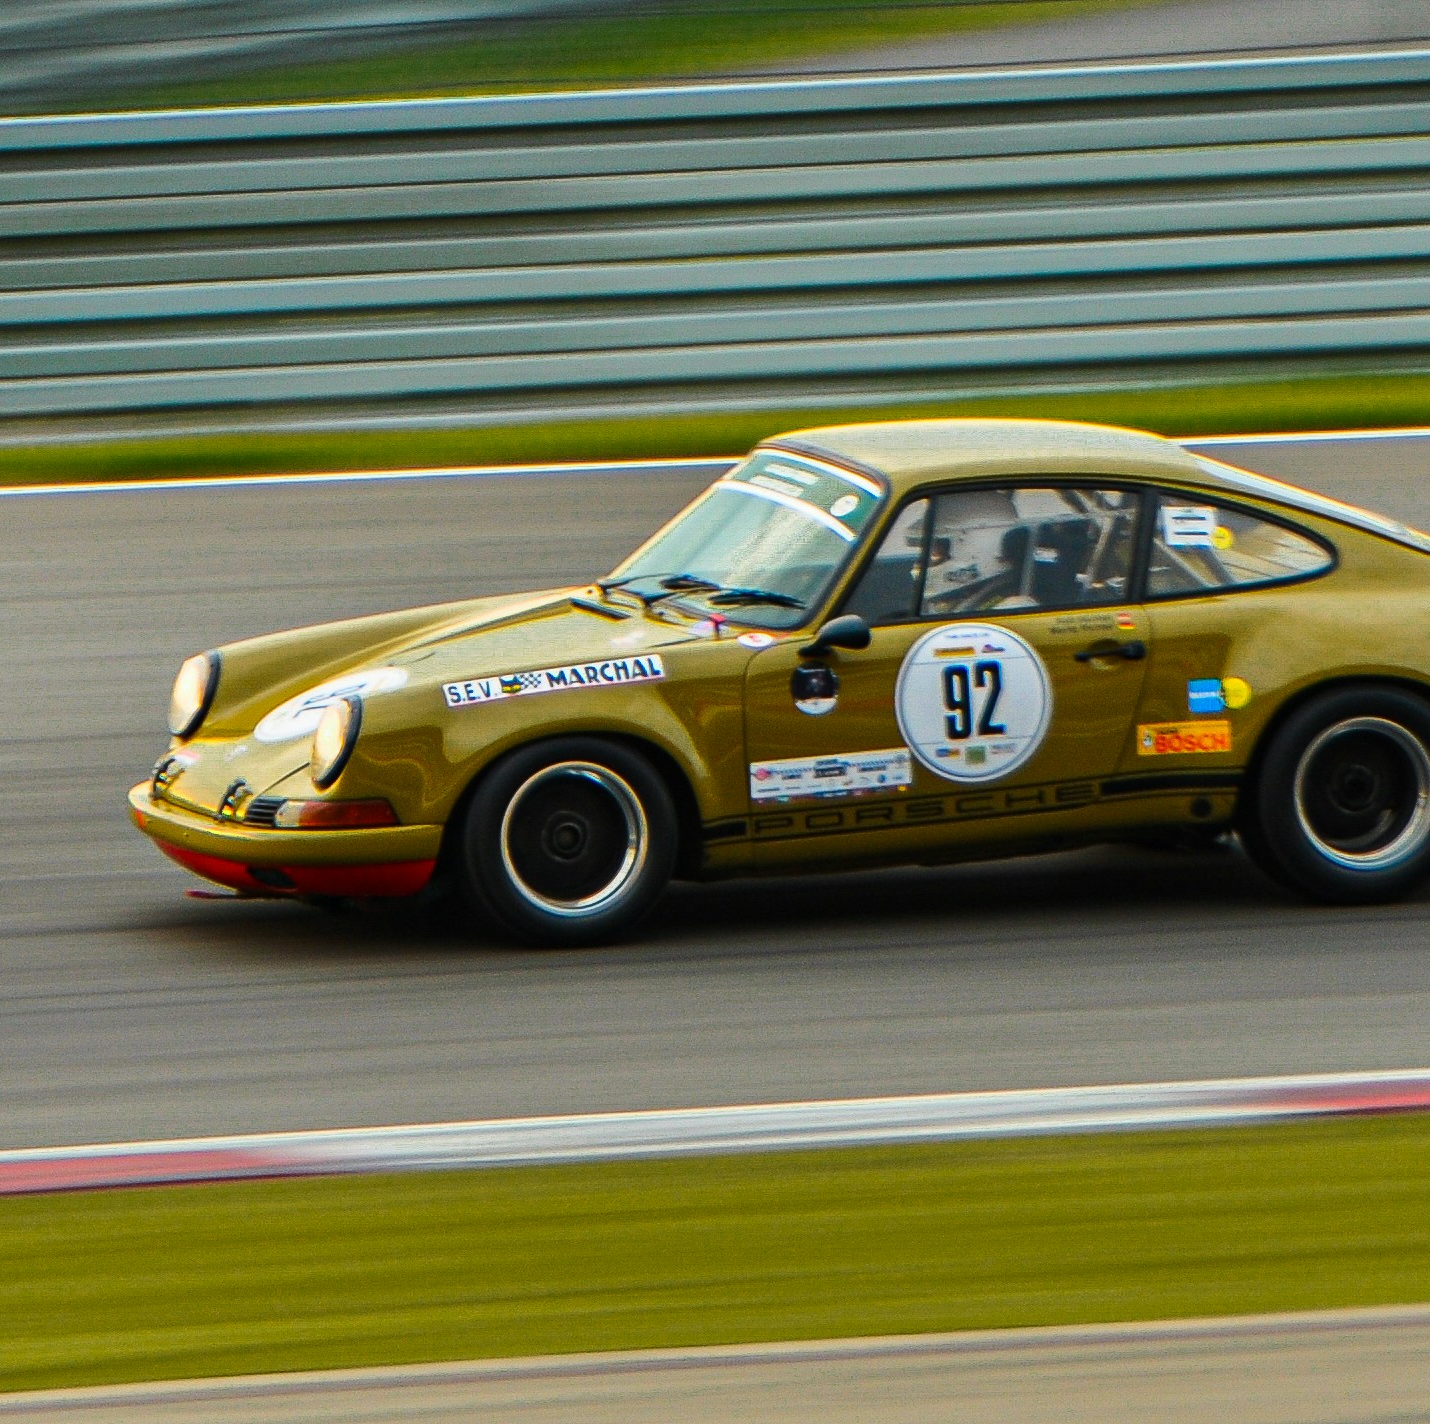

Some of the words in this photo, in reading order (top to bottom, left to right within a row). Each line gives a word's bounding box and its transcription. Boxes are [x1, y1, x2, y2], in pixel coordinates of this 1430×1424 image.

[545, 657, 662, 689] MARCHAL
[943, 659, 1007, 740] 92
[1155, 733, 1229, 753] BOSCH
[754, 783, 1094, 833] PORSCHE
